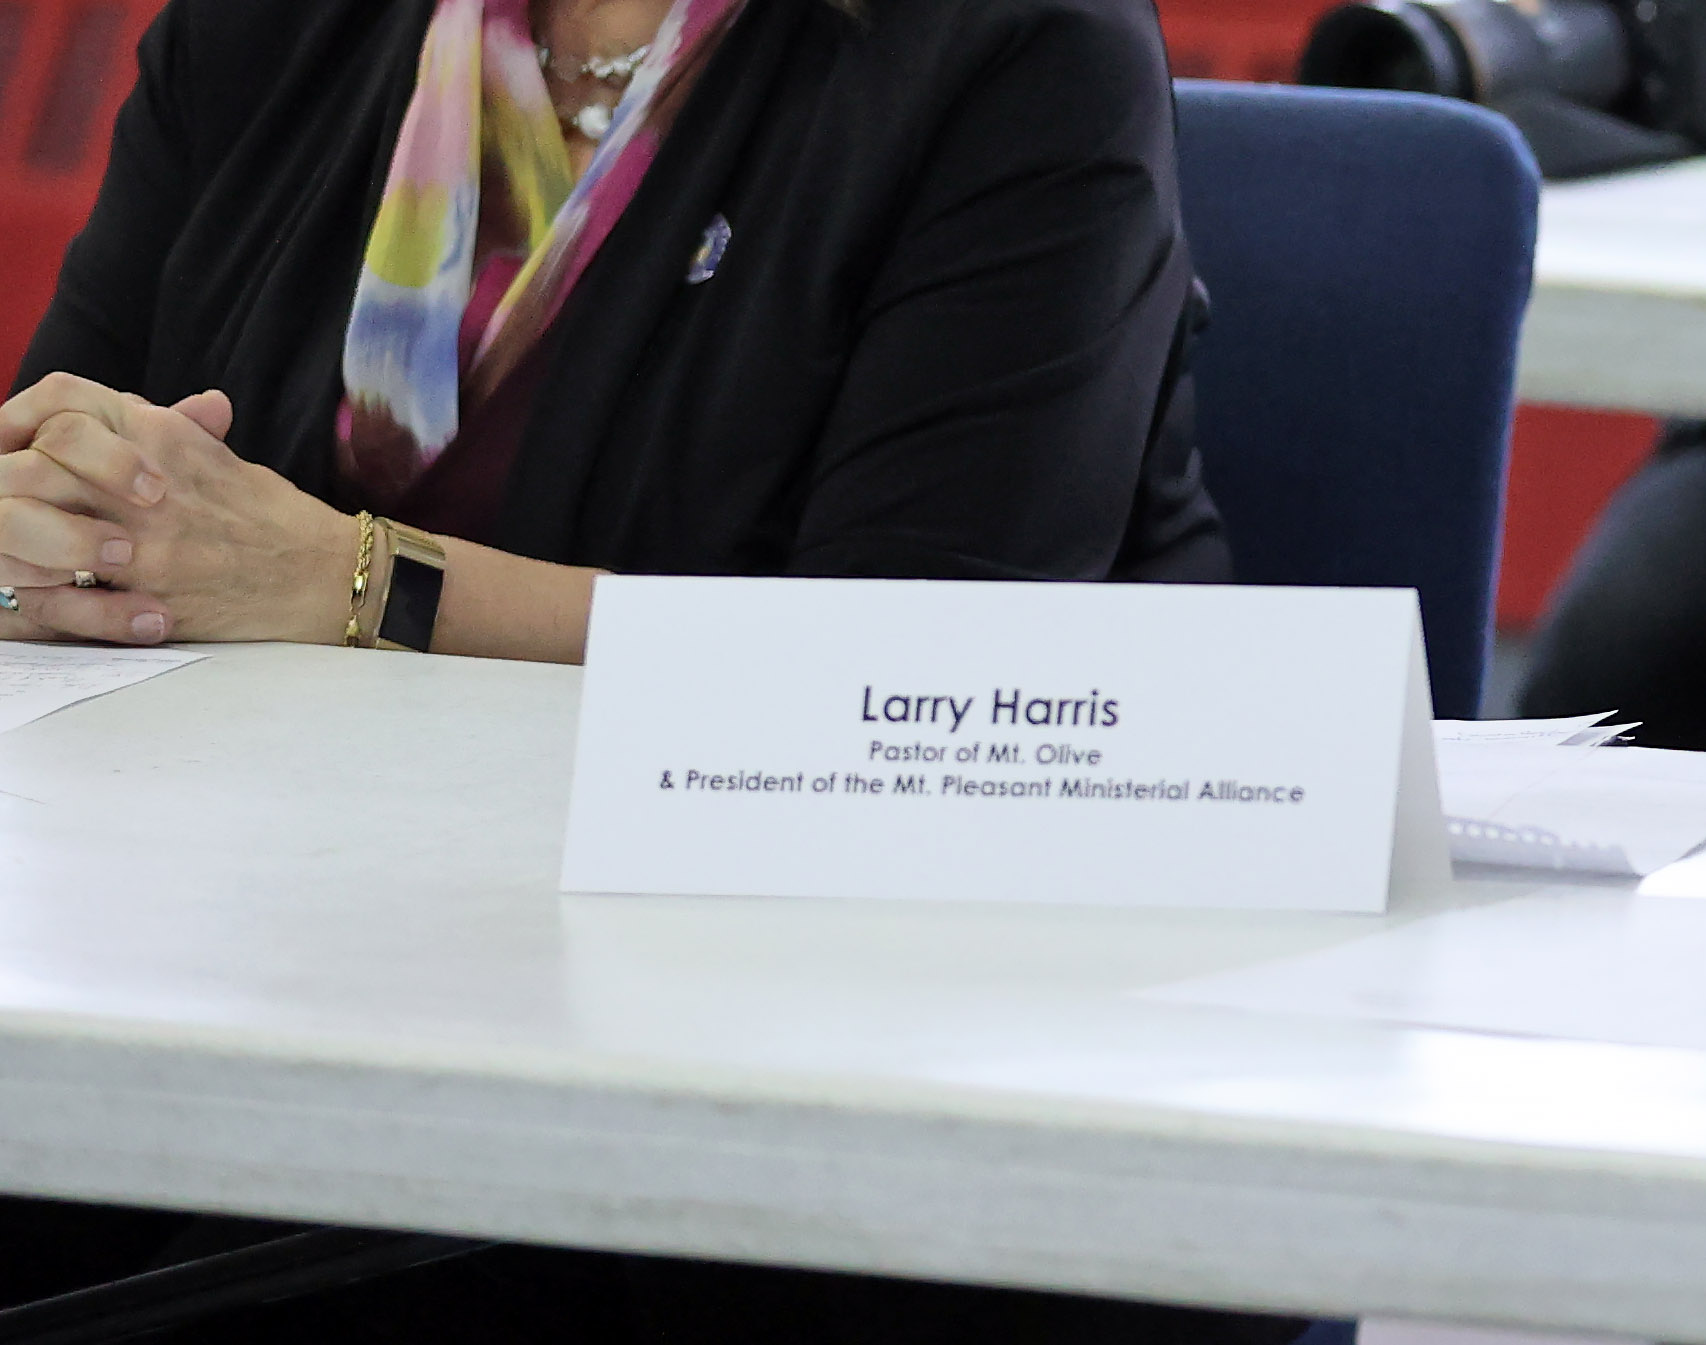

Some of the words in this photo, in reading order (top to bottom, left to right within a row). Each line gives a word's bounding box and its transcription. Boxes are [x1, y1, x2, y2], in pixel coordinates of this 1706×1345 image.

[861, 684, 975, 734] Larry
[991, 688, 1120, 728] Harris
[869, 739, 948, 763] Pastor
[955, 742, 981, 763] of
[986, 743, 1025, 765] Mt.
[1035, 743, 1104, 767] Olive
[659, 769, 675, 790] &
[686, 769, 803, 794] President
[812, 772, 838, 794] of
[844, 773, 885, 794] the
[892, 774, 932, 796] Mt.
[941, 775, 1052, 798] Pleasant
[1059, 777, 1190, 801] Ministerial
[1197, 780, 1305, 803] Alliance
